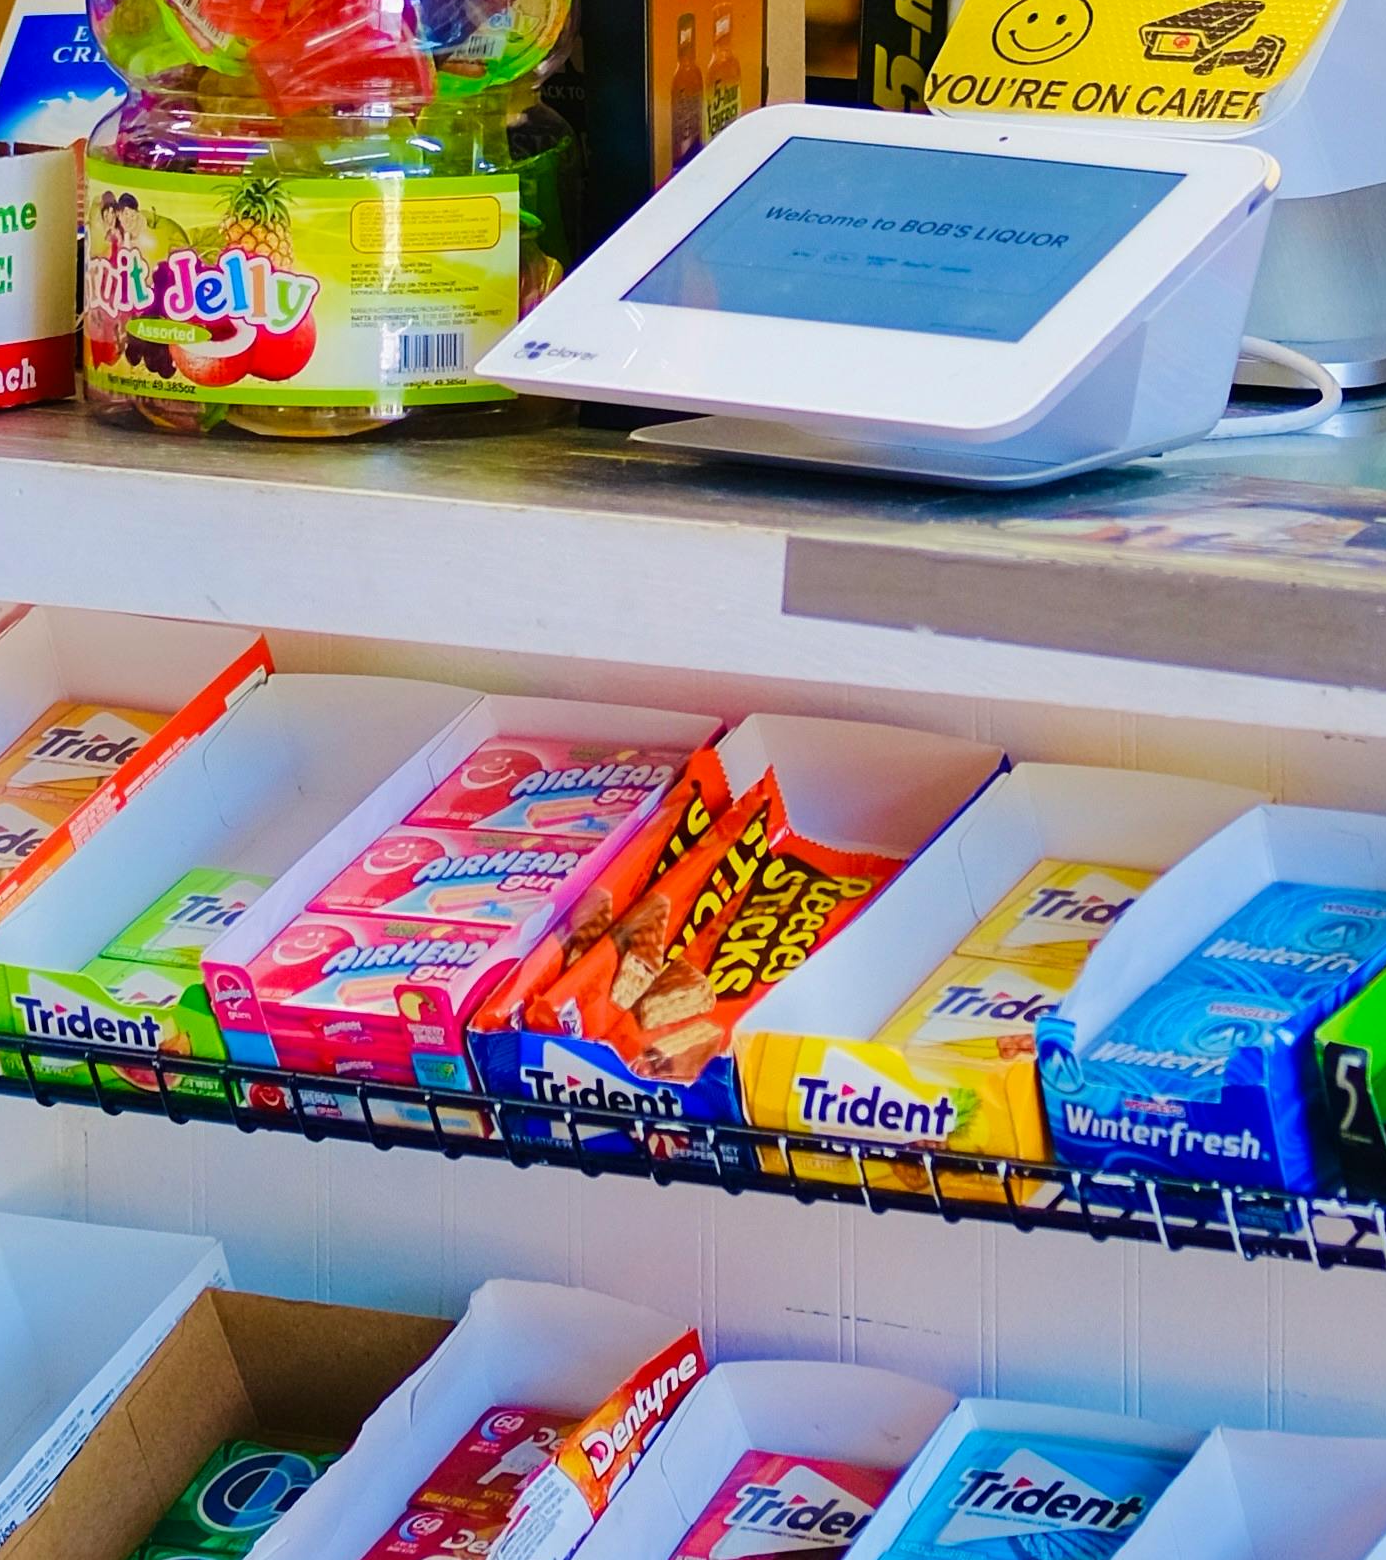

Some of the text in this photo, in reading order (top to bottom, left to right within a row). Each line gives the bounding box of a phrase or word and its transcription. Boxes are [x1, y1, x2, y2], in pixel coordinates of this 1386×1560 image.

[926, 72, 1268, 123] YOU'RE ON CAMER
[764, 203, 1071, 251] Welcome to BOB'S LIQUOR
[87, 250, 153, 310] ruit
[167, 253, 315, 330] Jelly
[137, 321, 196, 342] Assorted
[544, 344, 599, 364] clover
[511, 762, 673, 799] AIRHEAD
[13, 993, 163, 1051] Trident
[794, 1076, 957, 1139] Trident
[1065, 1101, 1265, 1162] Winterfresh
[584, 1350, 699, 1475] Dentyne
[732, 1484, 873, 1544] Triden
[961, 1466, 1144, 1533] Trident
